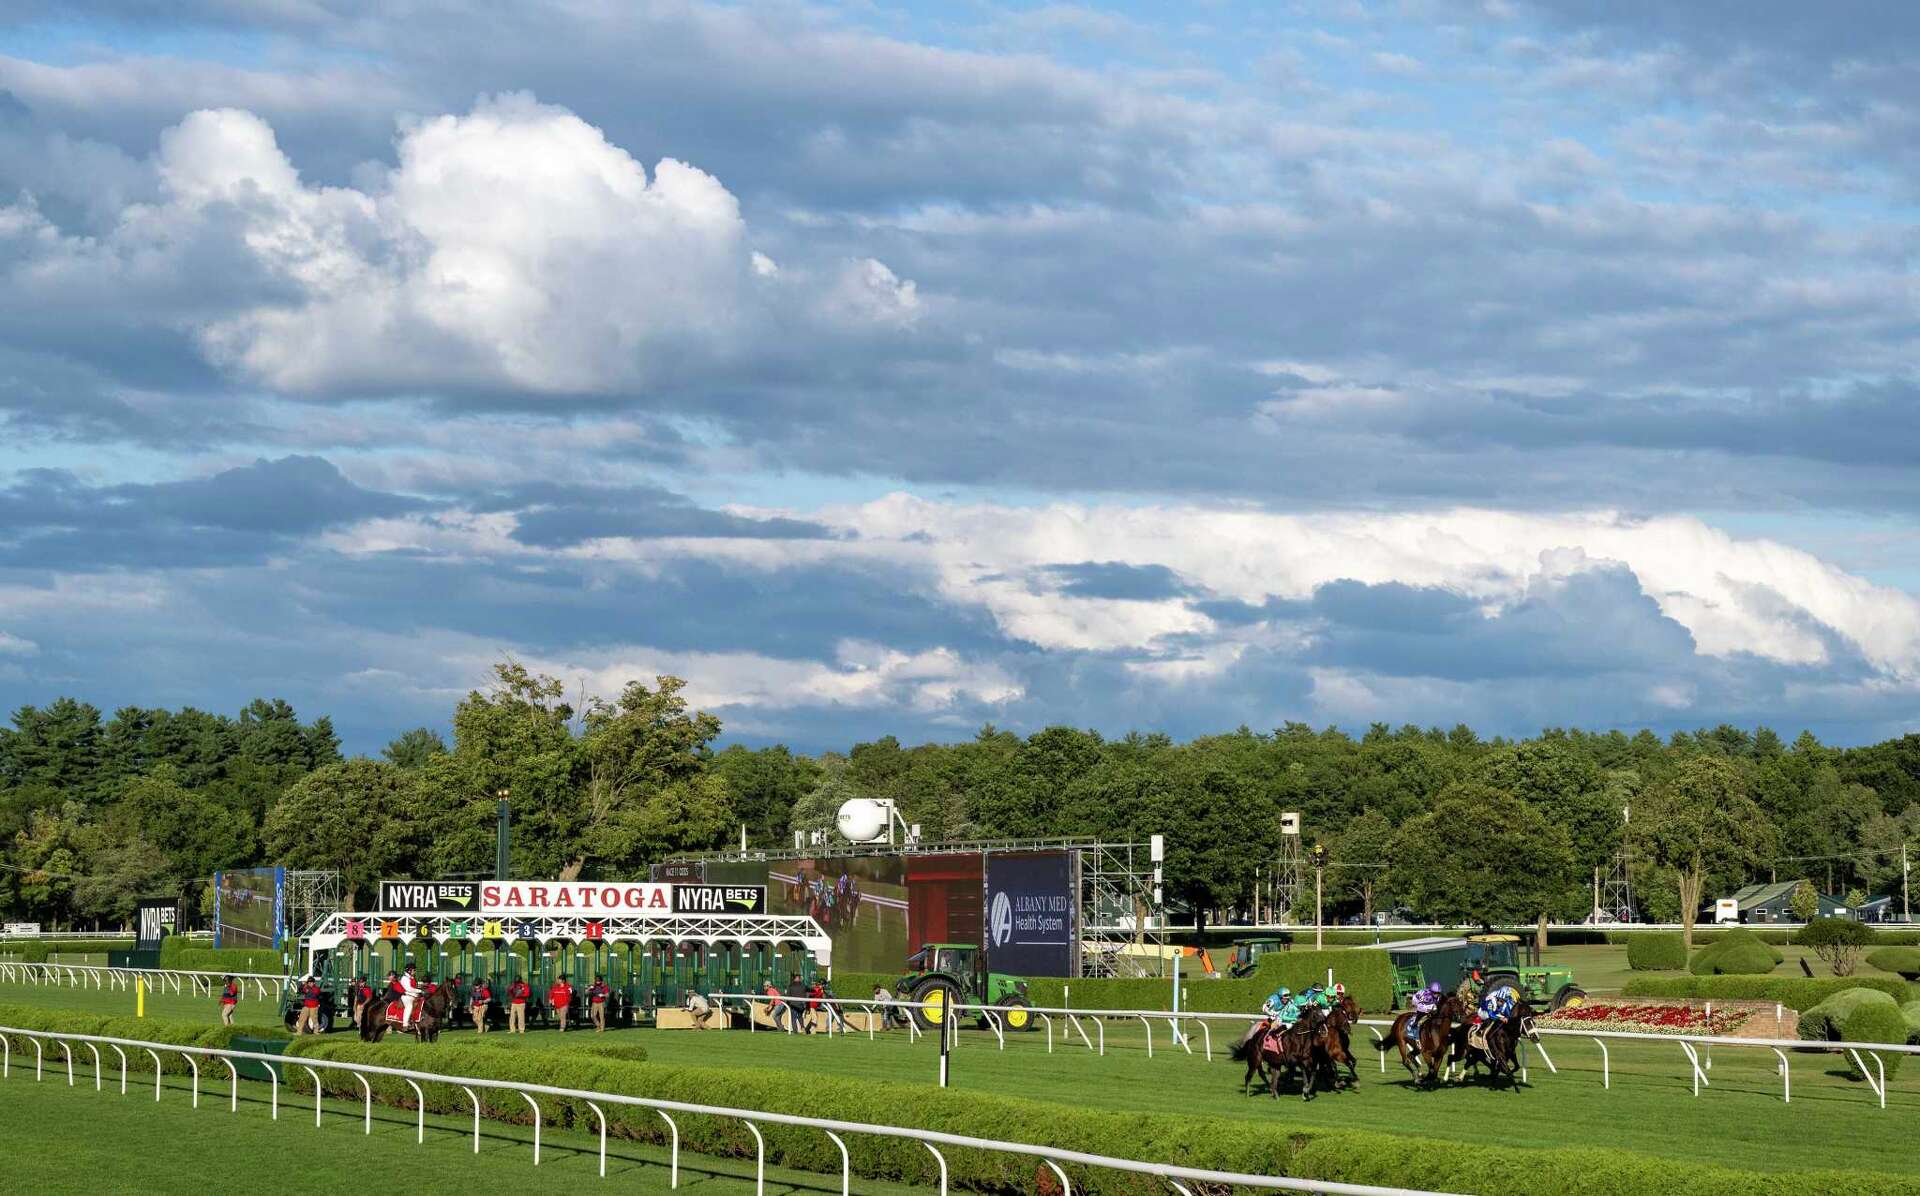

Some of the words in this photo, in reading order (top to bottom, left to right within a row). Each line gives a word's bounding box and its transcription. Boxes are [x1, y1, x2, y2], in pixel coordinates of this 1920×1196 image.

[389, 886, 437, 908] NYRA
[439, 886, 472, 897] BETS
[483, 886, 668, 908] SARATOGA
[679, 888, 724, 910] NYRA
[726, 889, 758, 899] BETS
[1015, 896, 1047, 912] ALBANY
[1049, 896, 1067, 912] MED
[141, 907, 160, 940] NYRA
[160, 906, 175, 923] BETS
[1015, 915, 1037, 930] Health
[1038, 915, 1063, 934] System
[352, 924, 359, 936] 8
[387, 925, 393, 936] 7
[420, 924, 428, 936] 6
[455, 925, 462, 937] 5
[488, 925, 495, 936] 4
[523, 925, 531, 936] 3
[591, 926, 597, 936] 1
